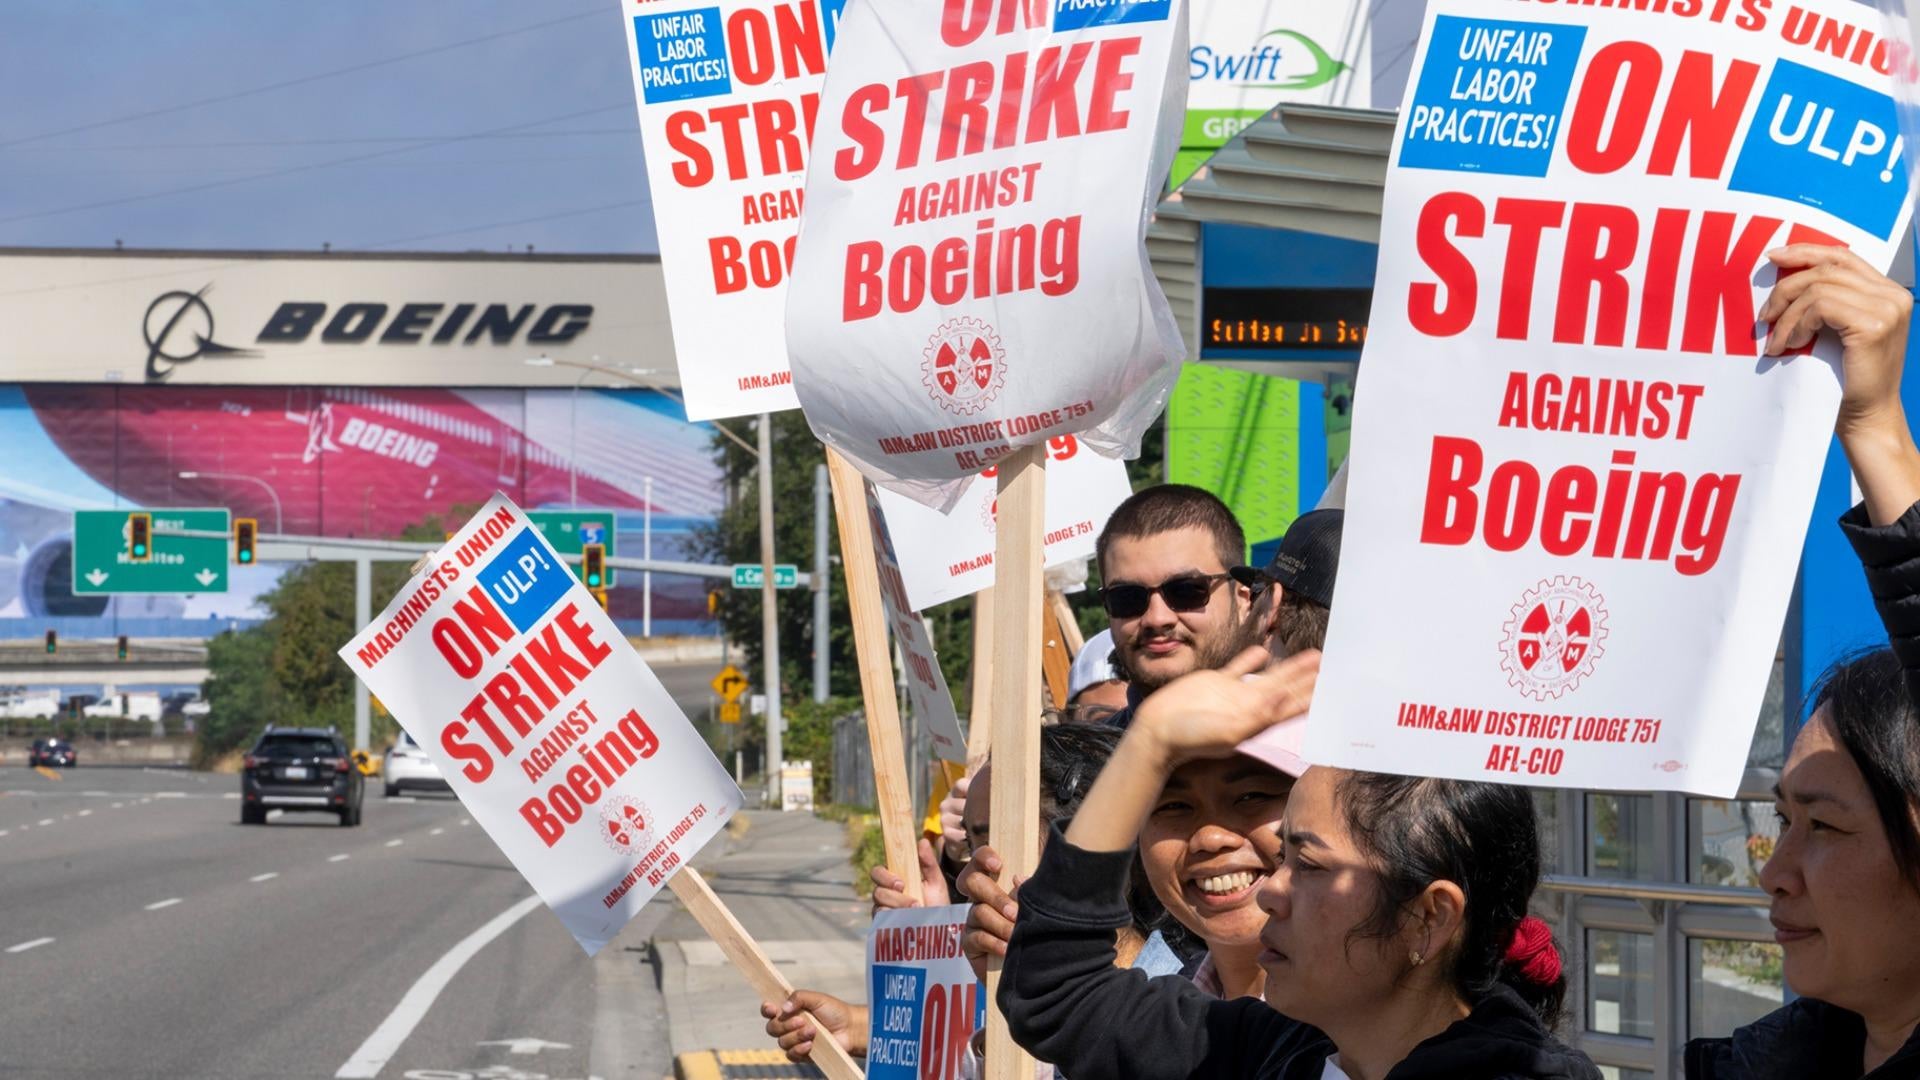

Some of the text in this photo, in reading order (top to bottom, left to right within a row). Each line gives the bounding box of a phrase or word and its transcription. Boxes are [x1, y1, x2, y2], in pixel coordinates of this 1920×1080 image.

[651, 14, 706, 39] UNFAIR
[657, 38, 707, 62] LABOR
[727, 0, 826, 86] ON
[1460, 26, 1553, 66] UNFAIR
[643, 59, 727, 88] PRACTICES!
[1190, 46, 1281, 80] Swift
[1450, 65, 1536, 105] LABOR
[834, 36, 1142, 182] STRIKE
[1409, 104, 1555, 150] PRACTICES!
[1566, 40, 1761, 180] ON
[1769, 93, 1904, 183] ULP!
[895, 162, 1041, 226] AGAINST
[842, 215, 1082, 323] Boeing
[257, 301, 595, 345] BOEING
[738, 371, 793, 391] IAM&AW
[1498, 371, 1705, 440] AGAINST
[339, 417, 438, 468] BOEING
[878, 400, 1095, 456] IAM&AW DISTRICT LODGE 751
[1420, 434, 1742, 577] Boeing
[493, 546, 550, 605] ULP!
[950, 553, 993, 577] IAM&AW
[1076, 520, 1094, 536] 751
[356, 506, 516, 669] MACHINISTS UNION
[431, 585, 516, 680] ON
[440, 601, 613, 784] STRIKE
[520, 699, 598, 784] AGAINST
[1397, 702, 1662, 744] IAM&AW DISTRICT LODGE 751
[518, 708, 660, 848] Boeing
[1485, 744, 1566, 777] AFL-CIO
[603, 874, 638, 909] IAM&AW
[633, 839, 669, 879] DISTRICT
[666, 816, 694, 845] LODGE
[692, 803, 708, 822] 751
[647, 852, 681, 887] AFL-CIO
[875, 923, 966, 962] MACHINIST
[884, 973, 917, 1001] UNFAIR
[883, 1005, 912, 1033] LABOR
[920, 983, 976, 1080] ON
[871, 1037, 919, 1067] PRACTICES!
